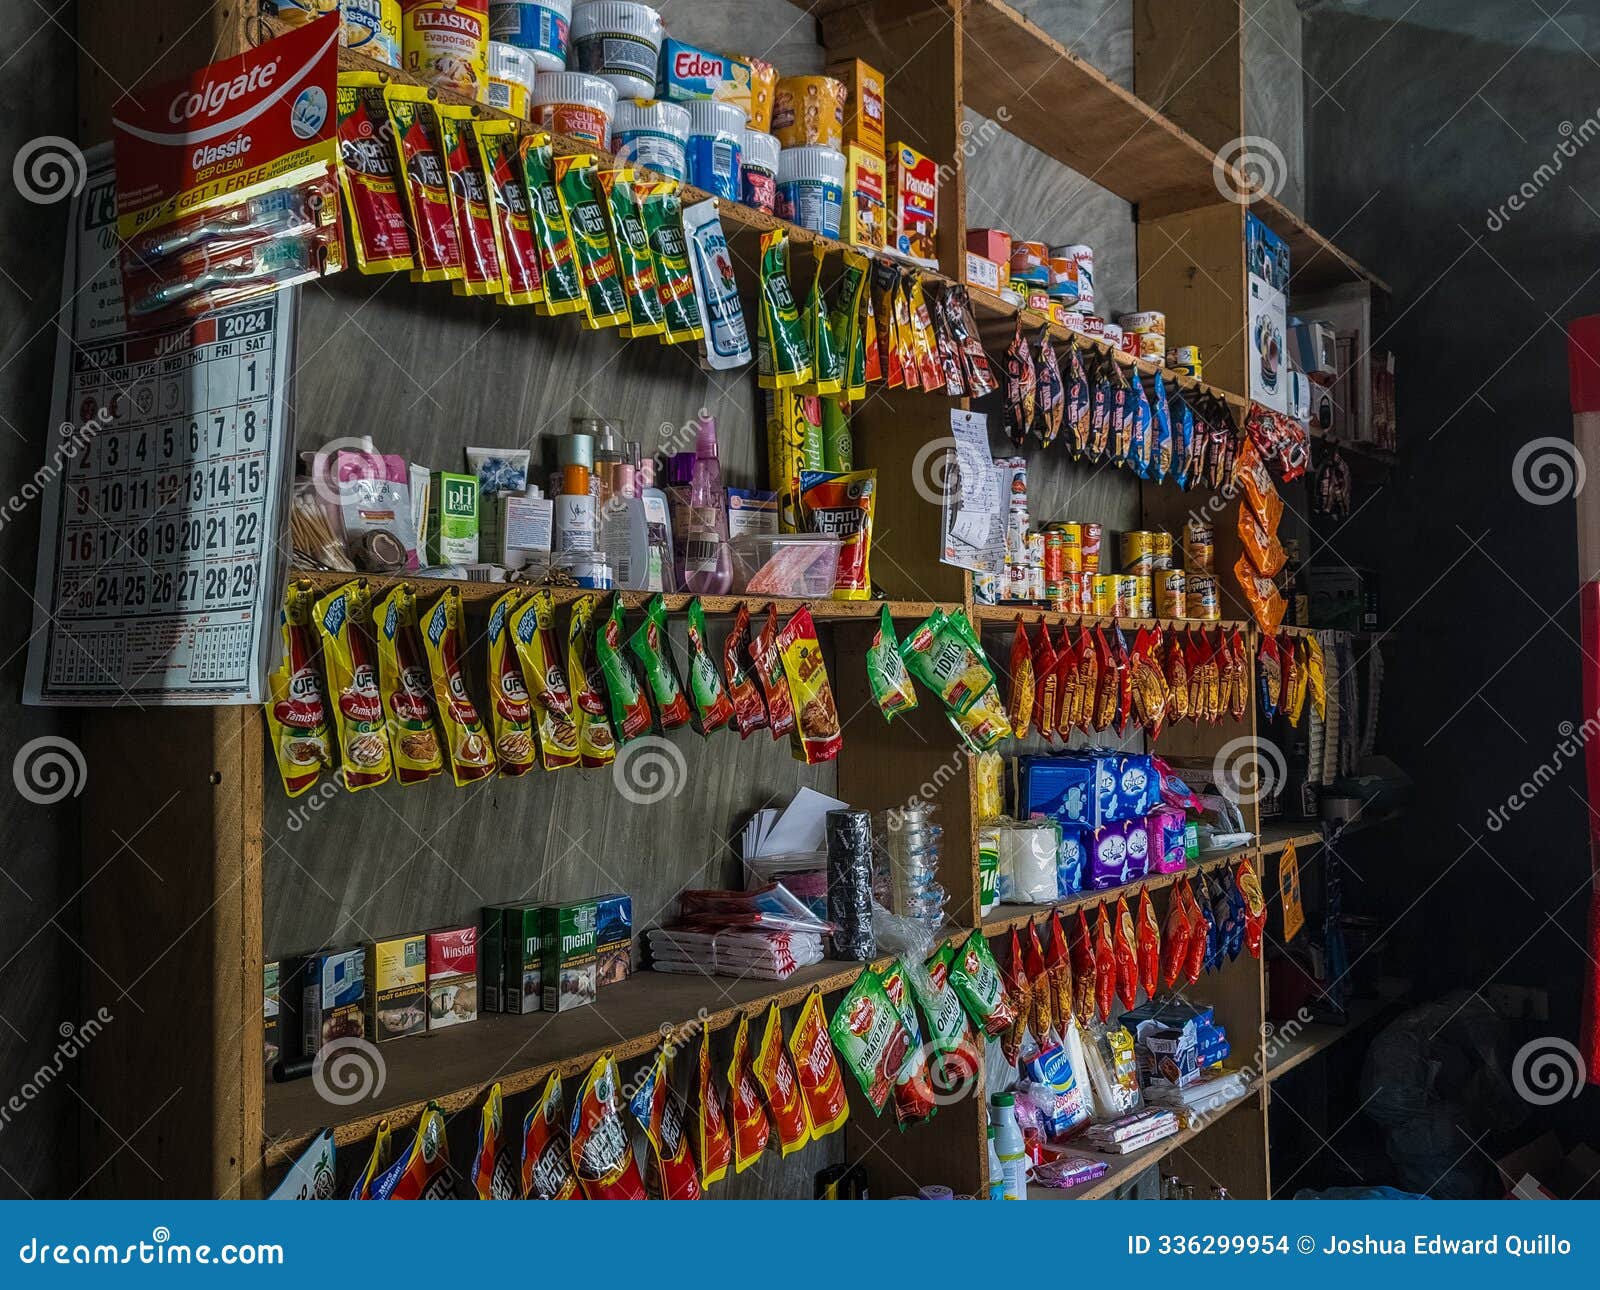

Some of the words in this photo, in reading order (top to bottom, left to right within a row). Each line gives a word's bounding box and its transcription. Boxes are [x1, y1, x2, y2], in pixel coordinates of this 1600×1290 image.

[417, 12, 482, 38] ALASKA
[674, 53, 723, 79] Eden
[168, 60, 280, 124] Colgate
[192, 133, 252, 170] Classic
[270, 156, 289, 171] WITH
[288, 148, 310, 164] FREE
[195, 168, 216, 184] DEEP
[215, 158, 244, 177] CLEAN
[135, 208, 161, 226] BUY
[167, 200, 178, 215] 5
[179, 187, 211, 208] GET
[212, 183, 222, 198] 1
[224, 167, 267, 193] FREE
[224, 311, 266, 338] 2024
[154, 330, 191, 355] JUNE
[80, 374, 101, 387] SUN
[164, 358, 183, 371] WED
[187, 352, 204, 364] THU
[215, 344, 233, 357] FRI
[245, 336, 266, 351] SAT
[247, 360, 257, 392] 1
[108, 437, 118, 466] 3
[135, 433, 147, 462] 4
[164, 428, 174, 458] 5
[189, 422, 199, 453] 6
[214, 416, 225, 448] 7
[244, 410, 256, 443] 8
[77, 486, 90, 515] 9
[102, 483, 123, 513] 10
[130, 480, 148, 510] 11
[183, 470, 203, 503] 13
[209, 465, 230, 498] 14
[238, 461, 259, 494] 15
[448, 485, 473, 511] pH
[454, 503, 473, 512] care
[67, 531, 92, 561] 16
[100, 530, 121, 559] 17
[128, 527, 148, 558] 18
[155, 523, 176, 555] 19
[180, 519, 202, 552] 20
[206, 516, 227, 549] 21
[235, 512, 258, 546] 22
[95, 577, 118, 606] 24
[124, 575, 146, 605] 25
[151, 572, 172, 604] 26
[177, 570, 199, 602] 27
[204, 567, 228, 600] 28
[231, 563, 254, 598] 29
[932, 643, 962, 681] TIDBITS
[442, 943, 474, 960] Winston
[562, 931, 595, 954] MIGHTY
[378, 991, 395, 1002] FOOT
[937, 992, 958, 1032] ORIGIN
[858, 1034, 881, 1073] TOMATO
